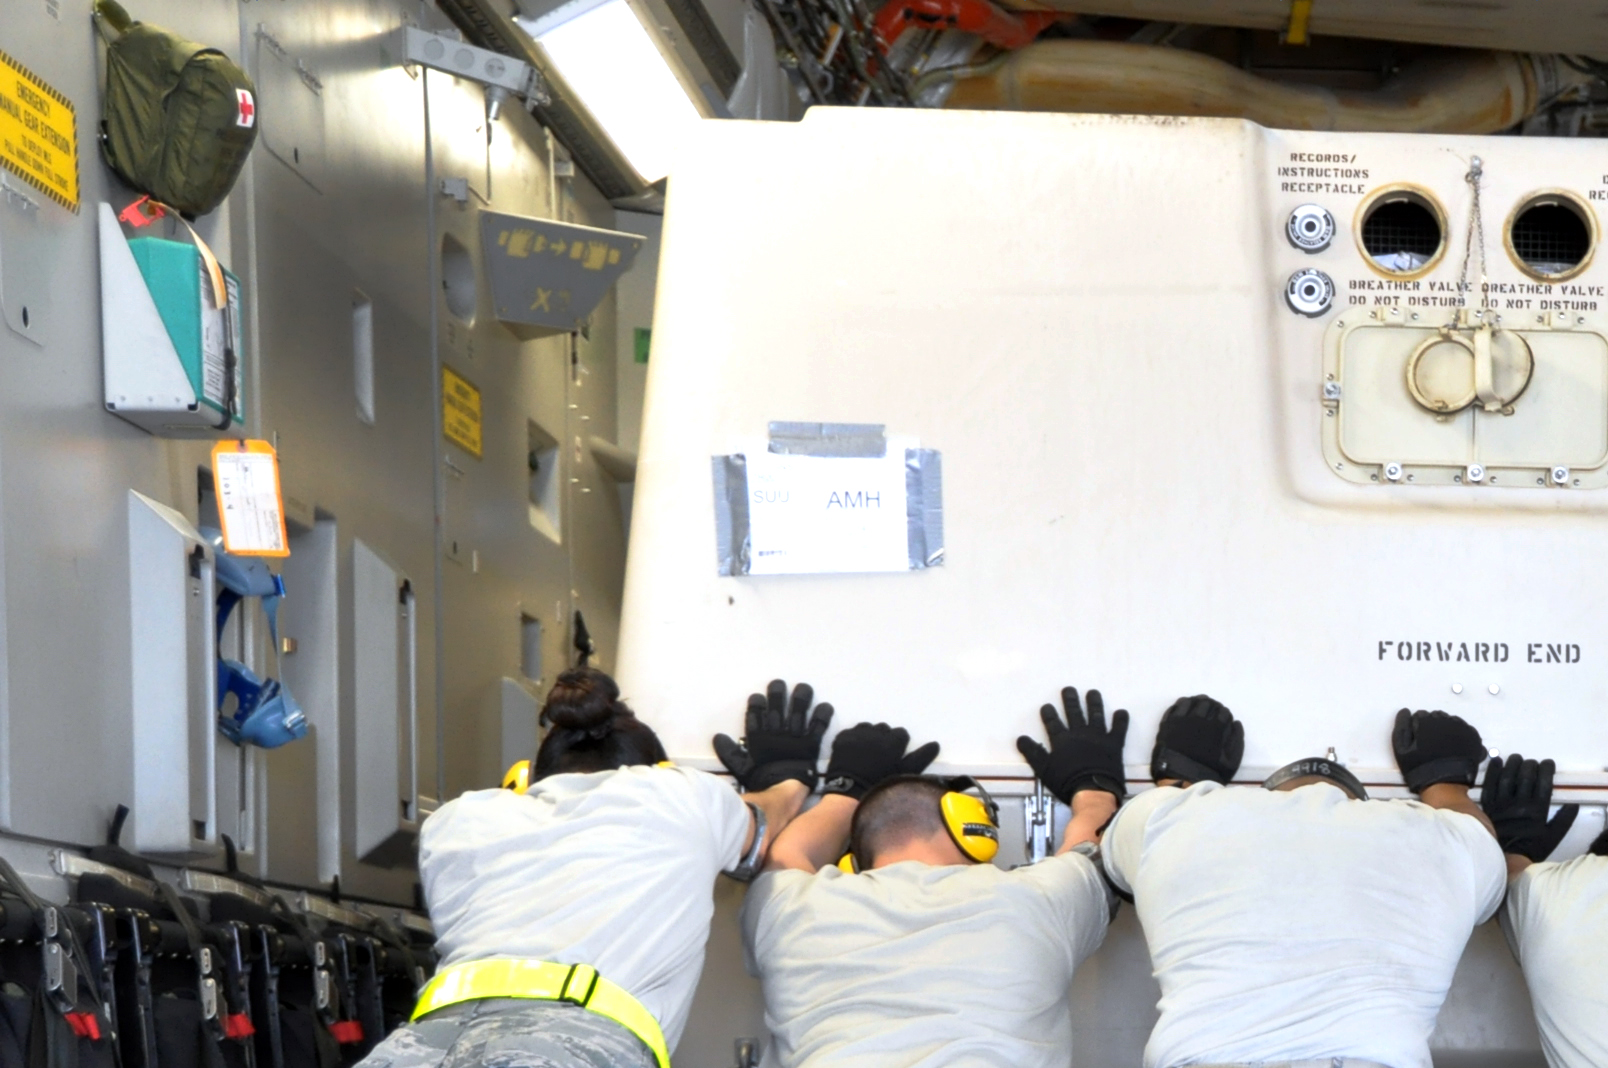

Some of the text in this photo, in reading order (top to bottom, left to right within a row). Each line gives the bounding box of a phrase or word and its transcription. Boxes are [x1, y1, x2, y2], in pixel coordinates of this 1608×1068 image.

[16, 80, 50, 117] EMERGENCY
[24, 110, 39, 134] GEAR
[40, 121, 71, 156] EXTENSION
[1290, 153, 1357, 163] RECORDS/
[1278, 167, 1369, 179] INSTRUCTIONS
[1281, 182, 1365, 194] RECEPTACLE
[1349, 280, 1473, 292] BREATHER VALVE
[1482, 283, 1605, 296] BREATHER VALVE
[1349, 295, 1466, 307] DO NOT DISTURB
[1482, 299, 1598, 310] DO NOT DISTURB
[753, 490, 881, 509] SUU AMH
[1378, 641, 1581, 663] FORWARD END
